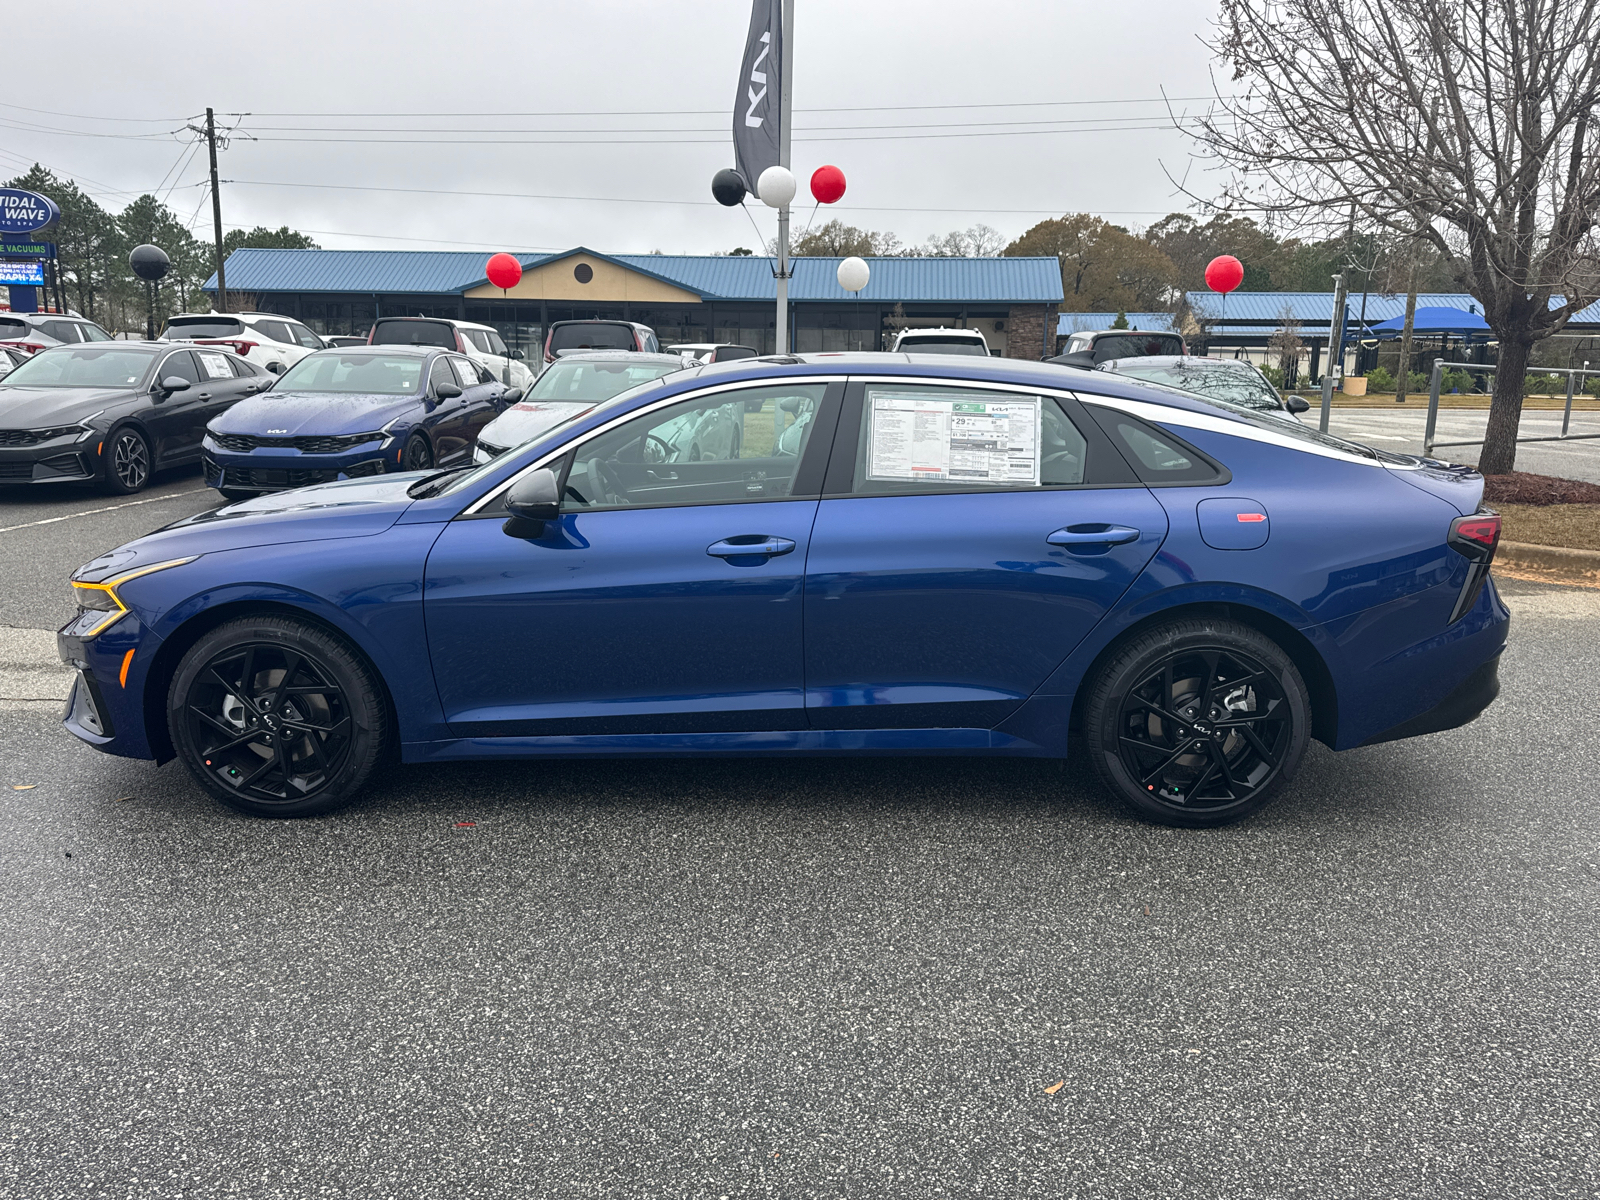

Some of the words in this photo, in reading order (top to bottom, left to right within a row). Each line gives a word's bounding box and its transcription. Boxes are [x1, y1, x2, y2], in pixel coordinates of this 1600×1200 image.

[0, 196, 37, 208] TIDAL
[5, 208, 46, 220] WAVE
[6, 245, 46, 254] VACUUMS
[955, 417, 966, 425] 29
